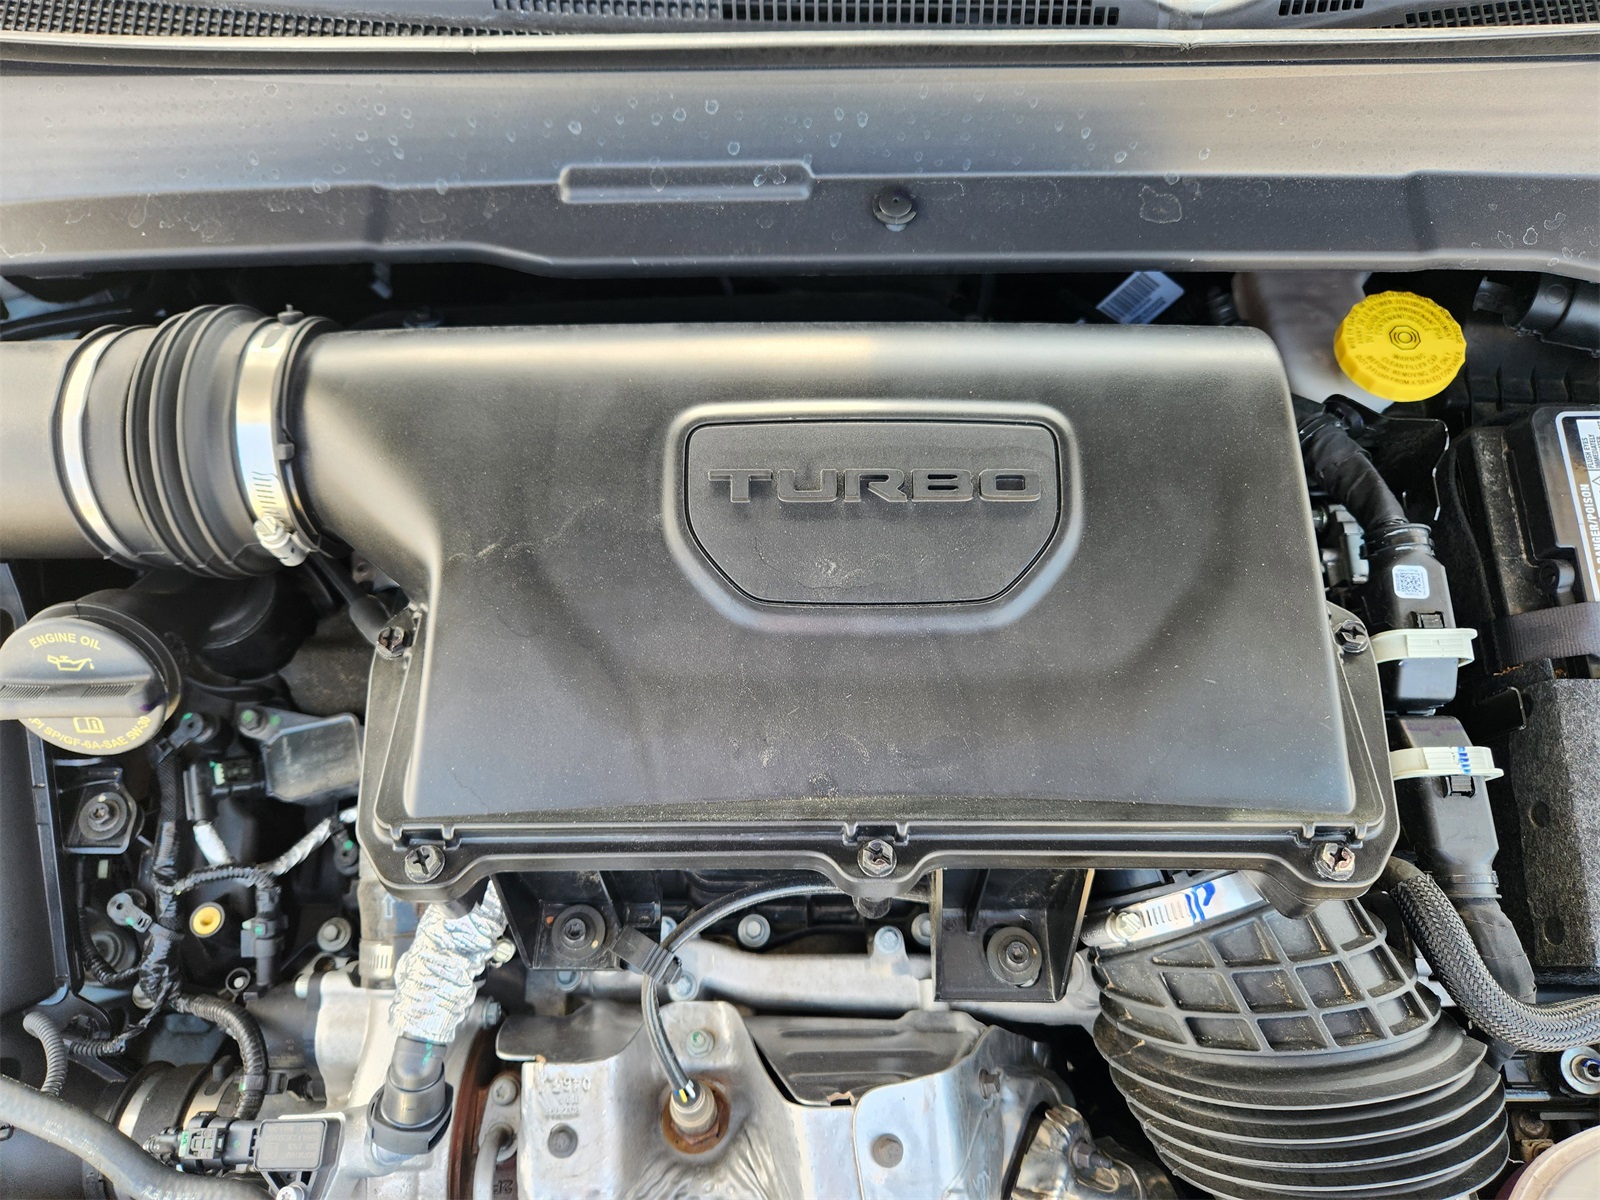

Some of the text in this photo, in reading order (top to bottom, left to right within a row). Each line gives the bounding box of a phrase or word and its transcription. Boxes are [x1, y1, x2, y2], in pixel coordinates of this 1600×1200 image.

[1582, 437, 1594, 469] FLUSH EYES
[708, 468, 1041, 503] TURBO
[29, 632, 101, 650] ENGINE OIL
[28, 717, 45, 729] PI
